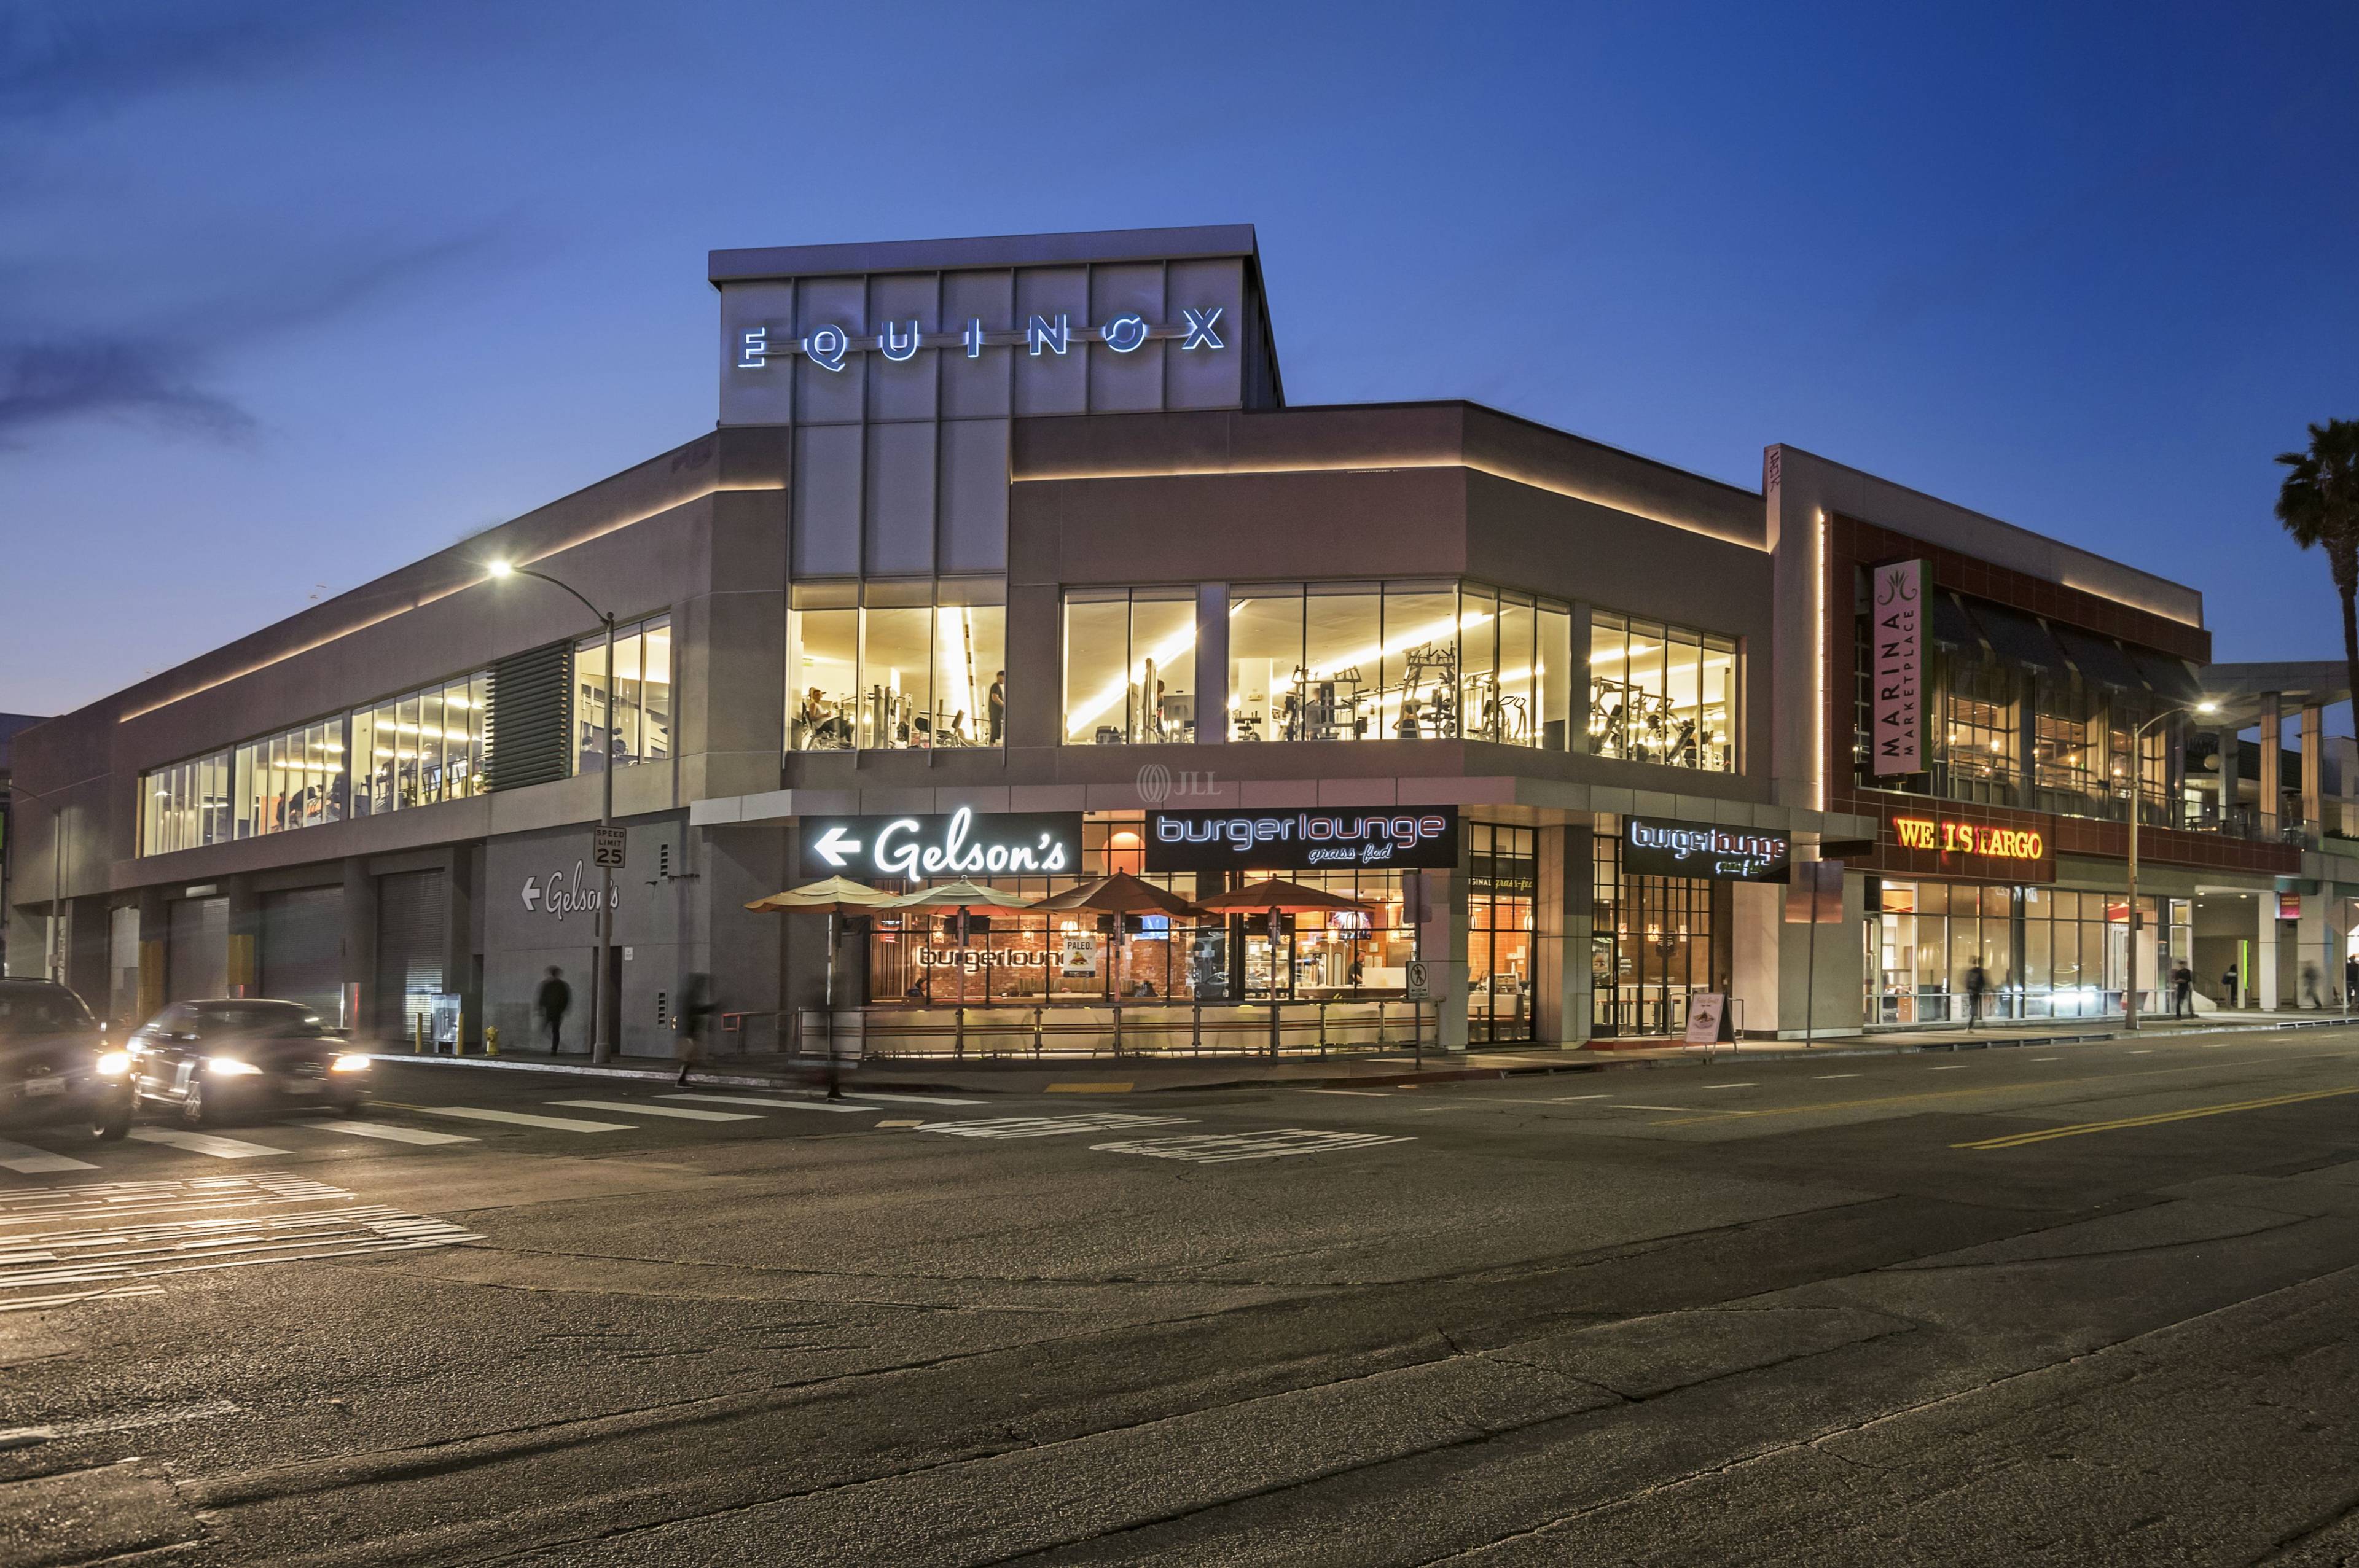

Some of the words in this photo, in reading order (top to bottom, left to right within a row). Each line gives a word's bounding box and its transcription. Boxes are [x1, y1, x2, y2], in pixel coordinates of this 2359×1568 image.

[738, 308, 1224, 372] EQUINOX
[1881, 613, 1900, 757] MARINA
[1904, 610, 1914, 755] MARKETPLACE
[597, 848, 622, 864] 25
[874, 807, 1066, 882] Gelson's
[1157, 814, 1446, 851] burgerlounge
[1309, 843, 1393, 864] grass-fed
[1896, 819, 1974, 853] WELLS
[1978, 829, 2043, 859] FARGO
